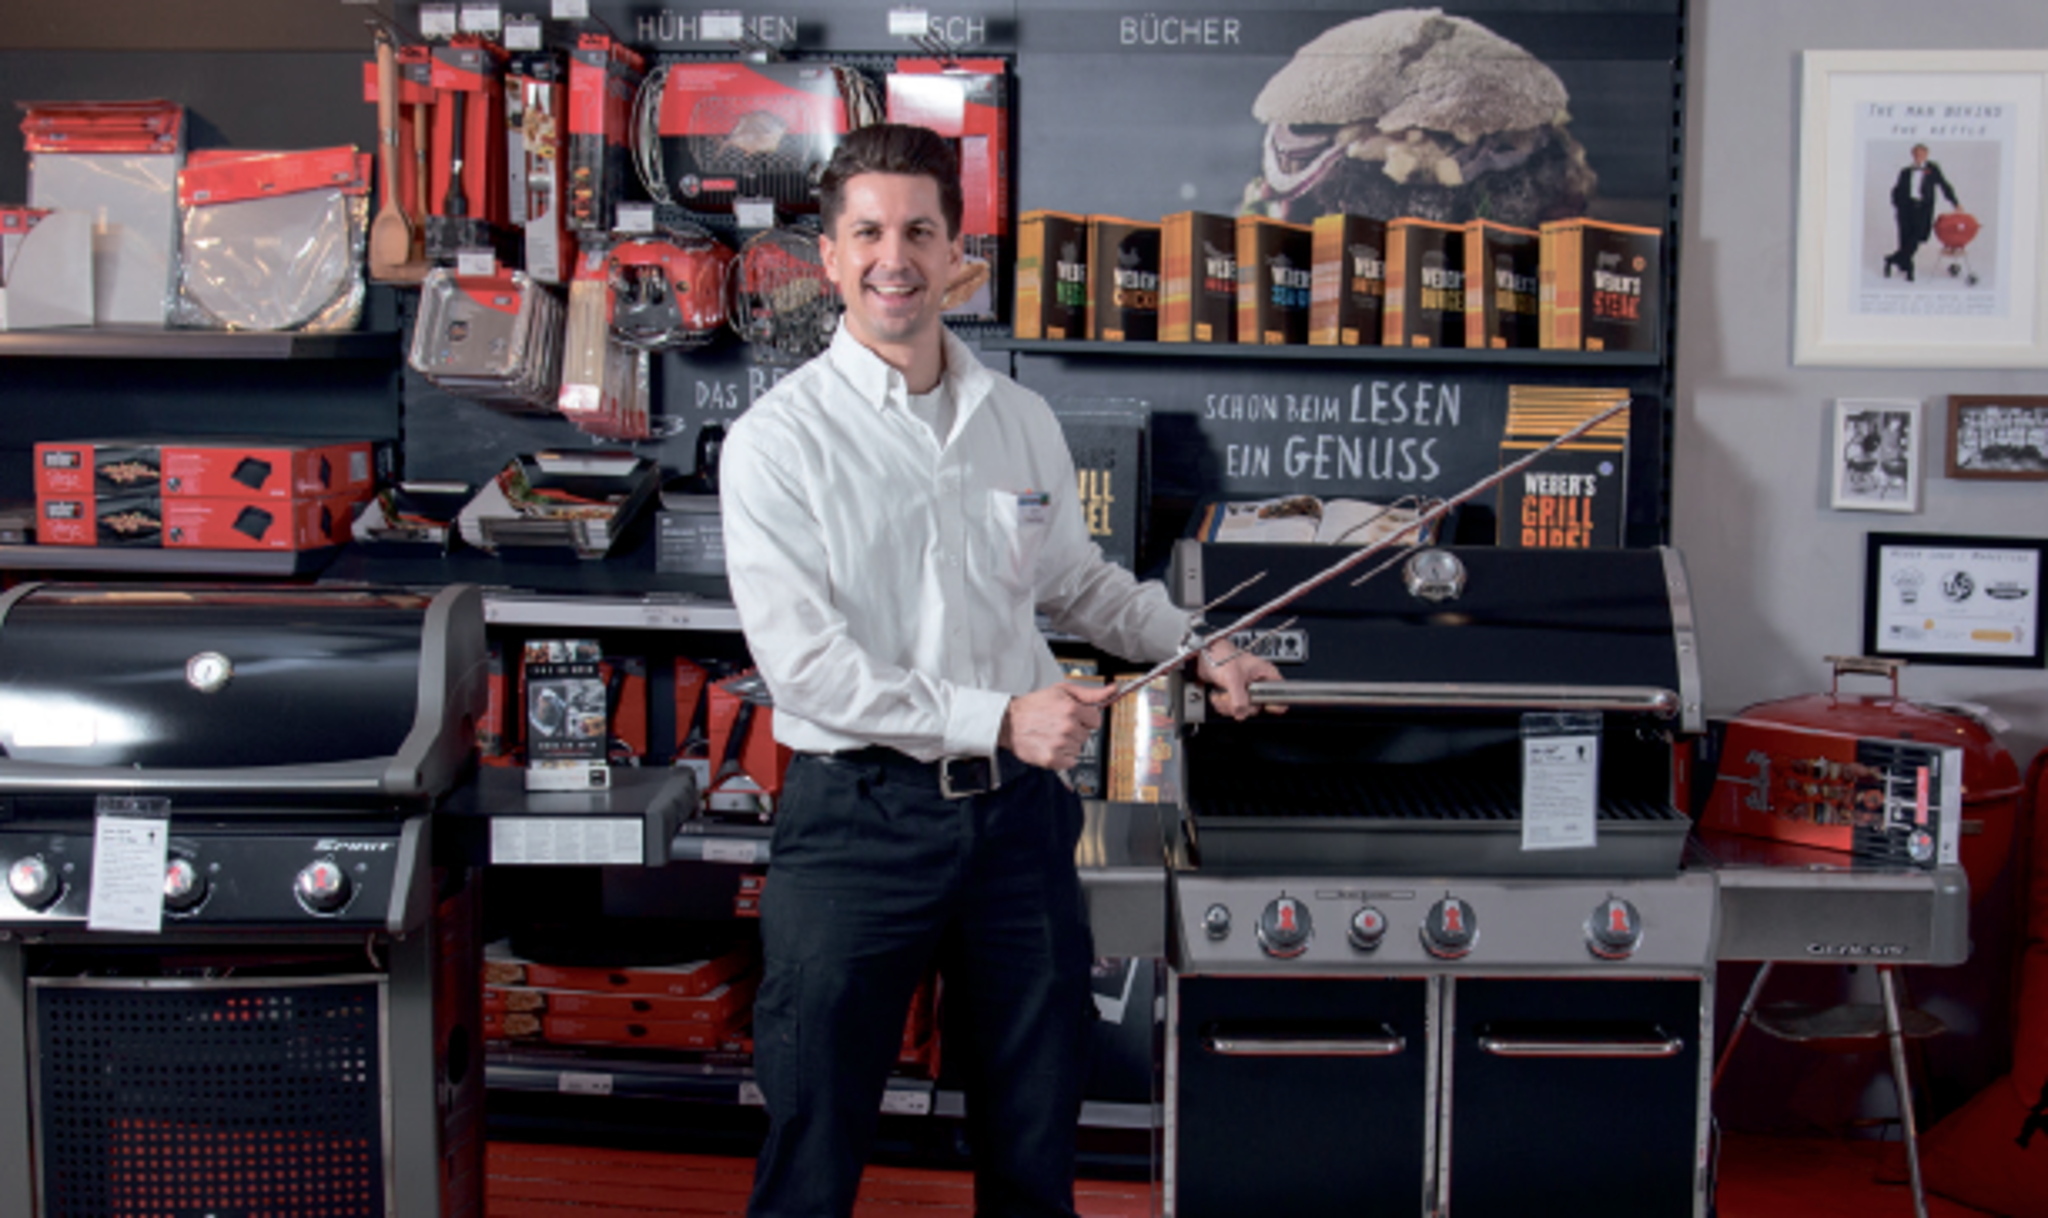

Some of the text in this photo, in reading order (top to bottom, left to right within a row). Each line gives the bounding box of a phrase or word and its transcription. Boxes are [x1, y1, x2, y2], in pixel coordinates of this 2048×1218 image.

[902, 15, 986, 43] SCH
[1118, 11, 1242, 46] BÜCHER
[1593, 289, 1640, 320] STEAK
[695, 380, 738, 410] DAS
[1283, 393, 1341, 423] BEIM
[1350, 380, 1461, 428] LESEN
[1226, 434, 1441, 482] EIN GENUSS
[1077, 468, 1115, 503] ILL
[1524, 472, 1597, 497] WEBER'S
[1521, 495, 1594, 530] GRILL
